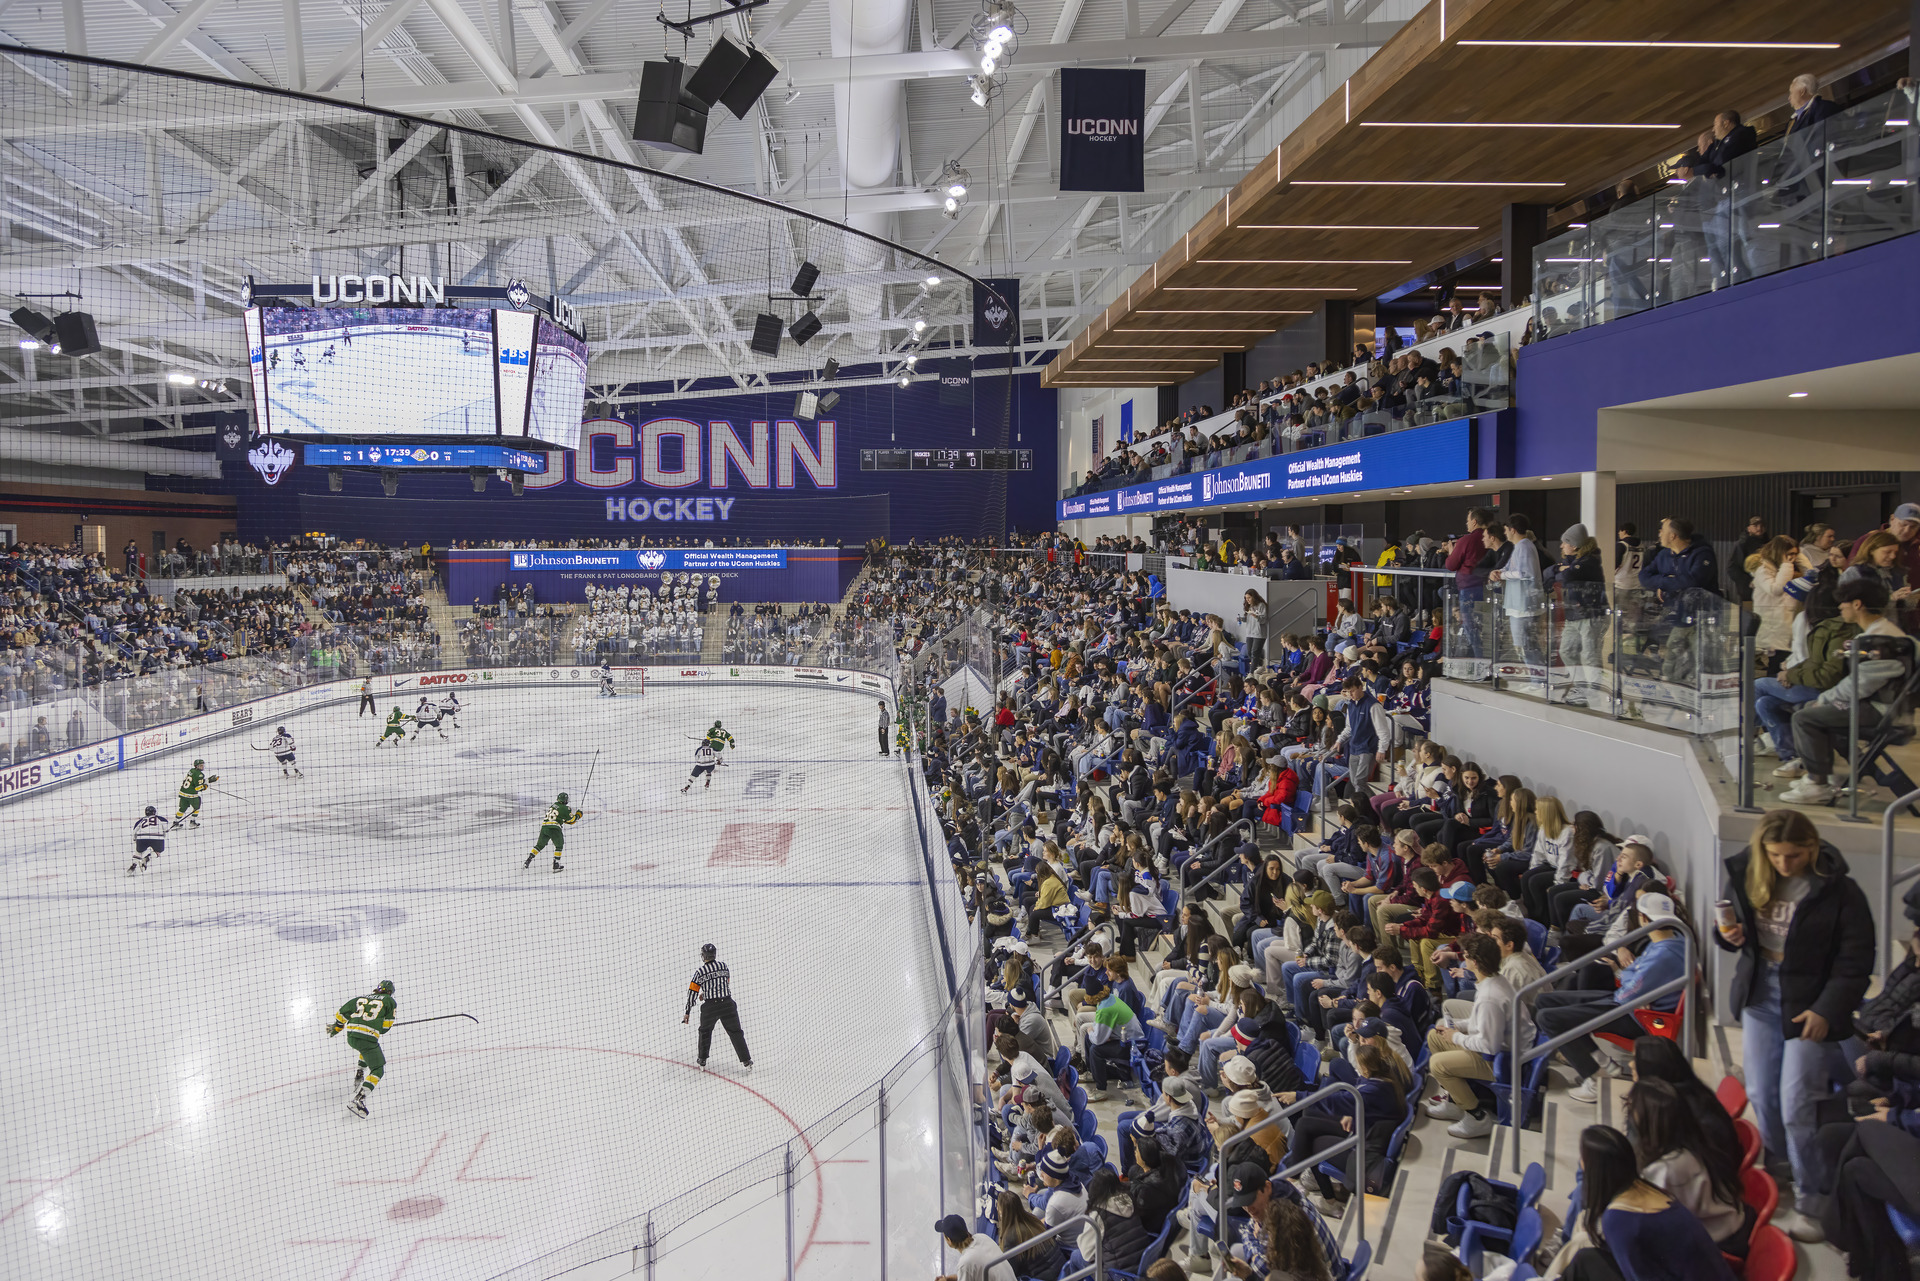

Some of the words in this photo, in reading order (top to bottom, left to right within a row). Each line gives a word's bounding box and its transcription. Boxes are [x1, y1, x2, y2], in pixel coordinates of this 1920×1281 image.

[1068, 118, 1138, 135] UCONN
[312, 275, 444, 303] UCONN
[500, 349, 527, 360] CBS
[358, 451, 363, 460] 1
[385, 448, 411, 456] 17:39
[430, 452, 439, 460] 0
[938, 450, 958, 460] 17:39
[926, 458, 928, 466] 1
[970, 458, 976, 466] 0
[1288, 462, 1306, 474] Official
[1306, 458, 1324, 471] Wealth
[1325, 452, 1360, 469] Management
[1288, 478, 1306, 490] Partner
[1306, 476, 1312, 488] of
[1312, 476, 1320, 486] the
[1321, 474, 1340, 486] UConn
[1340, 470, 1362, 484] Huskies
[606, 498, 735, 520] HOCKEY
[529, 554, 619, 568] JohnsonBRUNETTI
[1632, 554, 1640, 568] 2
[420, 674, 467, 686] DATTCO
[232, 707, 253, 720] BEAR'S
[714, 730, 726, 738] 37
[702, 748, 712, 756] 10
[0, 765, 40, 794] KIES
[142, 816, 158, 828] 29
